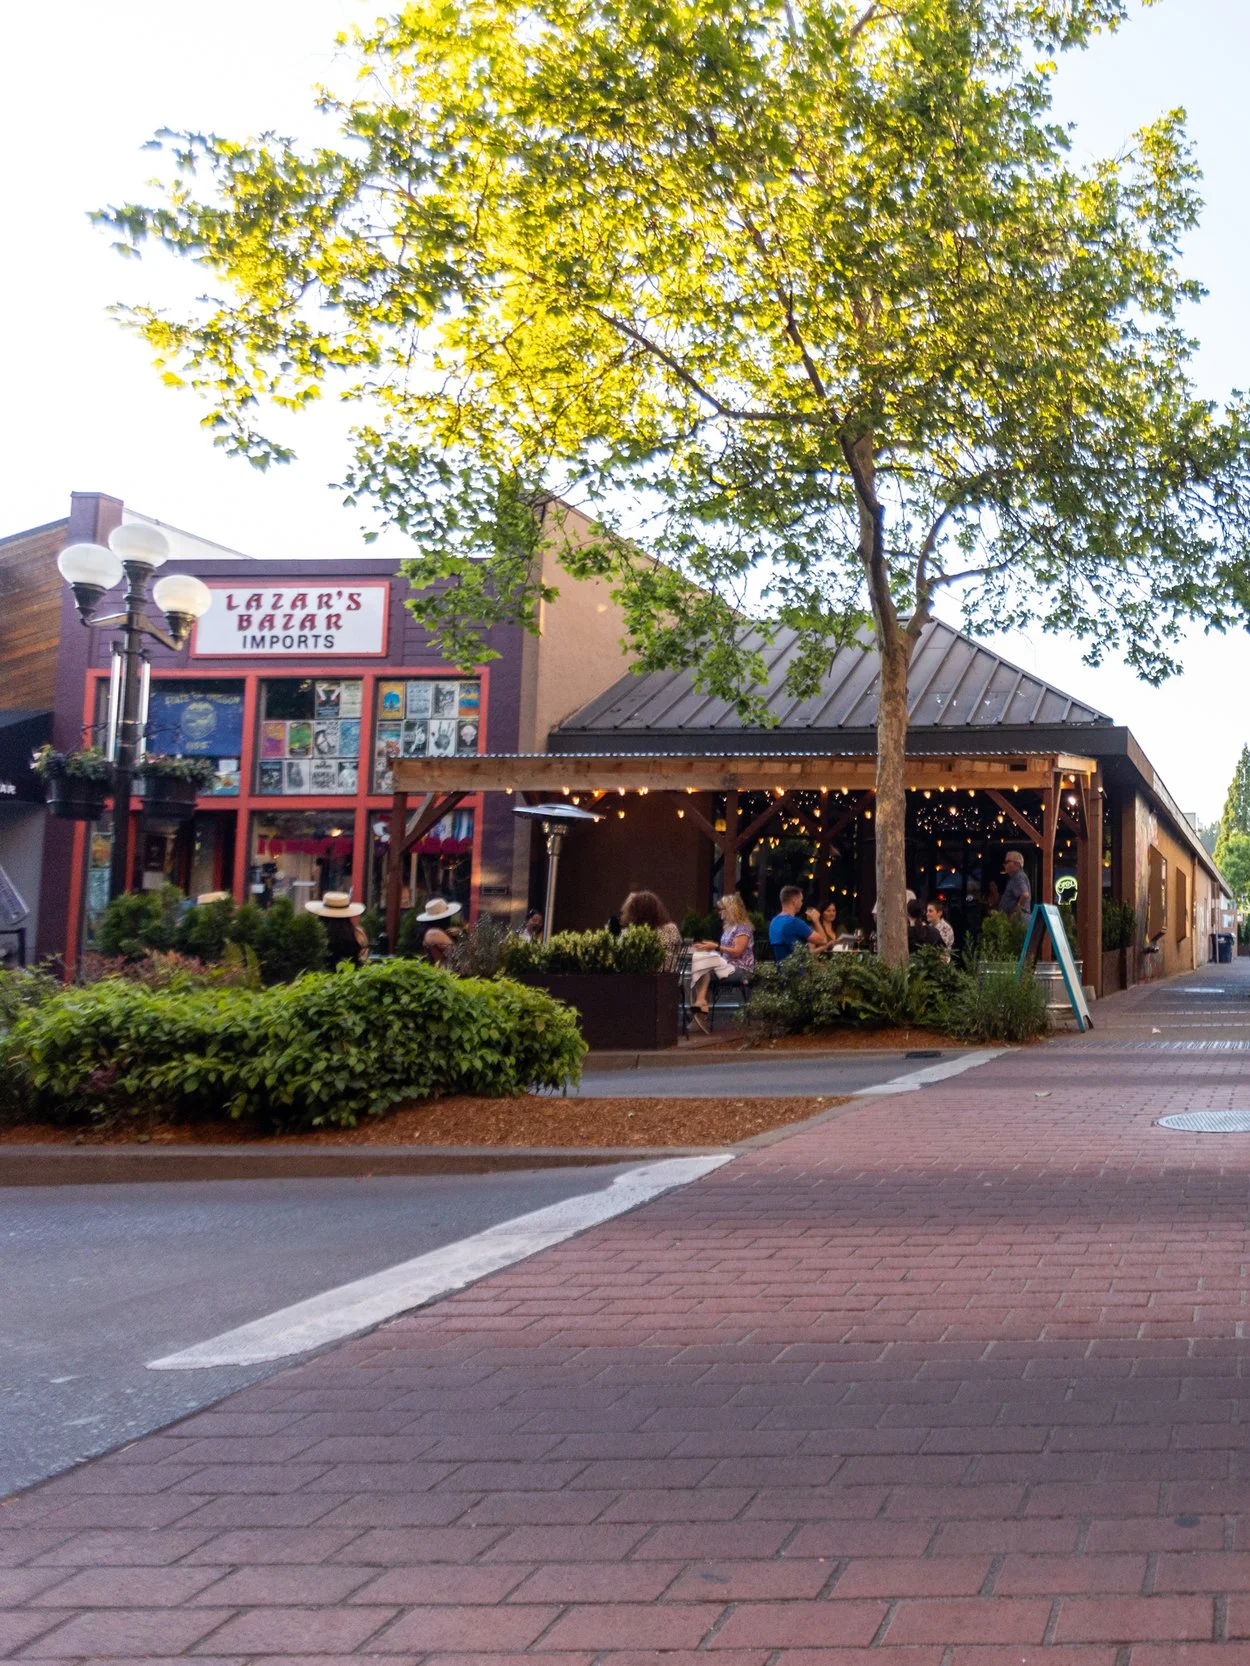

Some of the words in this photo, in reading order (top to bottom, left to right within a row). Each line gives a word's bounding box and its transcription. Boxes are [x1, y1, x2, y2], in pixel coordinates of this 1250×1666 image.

[225, 590, 362, 612] LAZAR'S
[237, 613, 344, 632] BAZAR
[242, 635, 335, 649] IMPORTS
